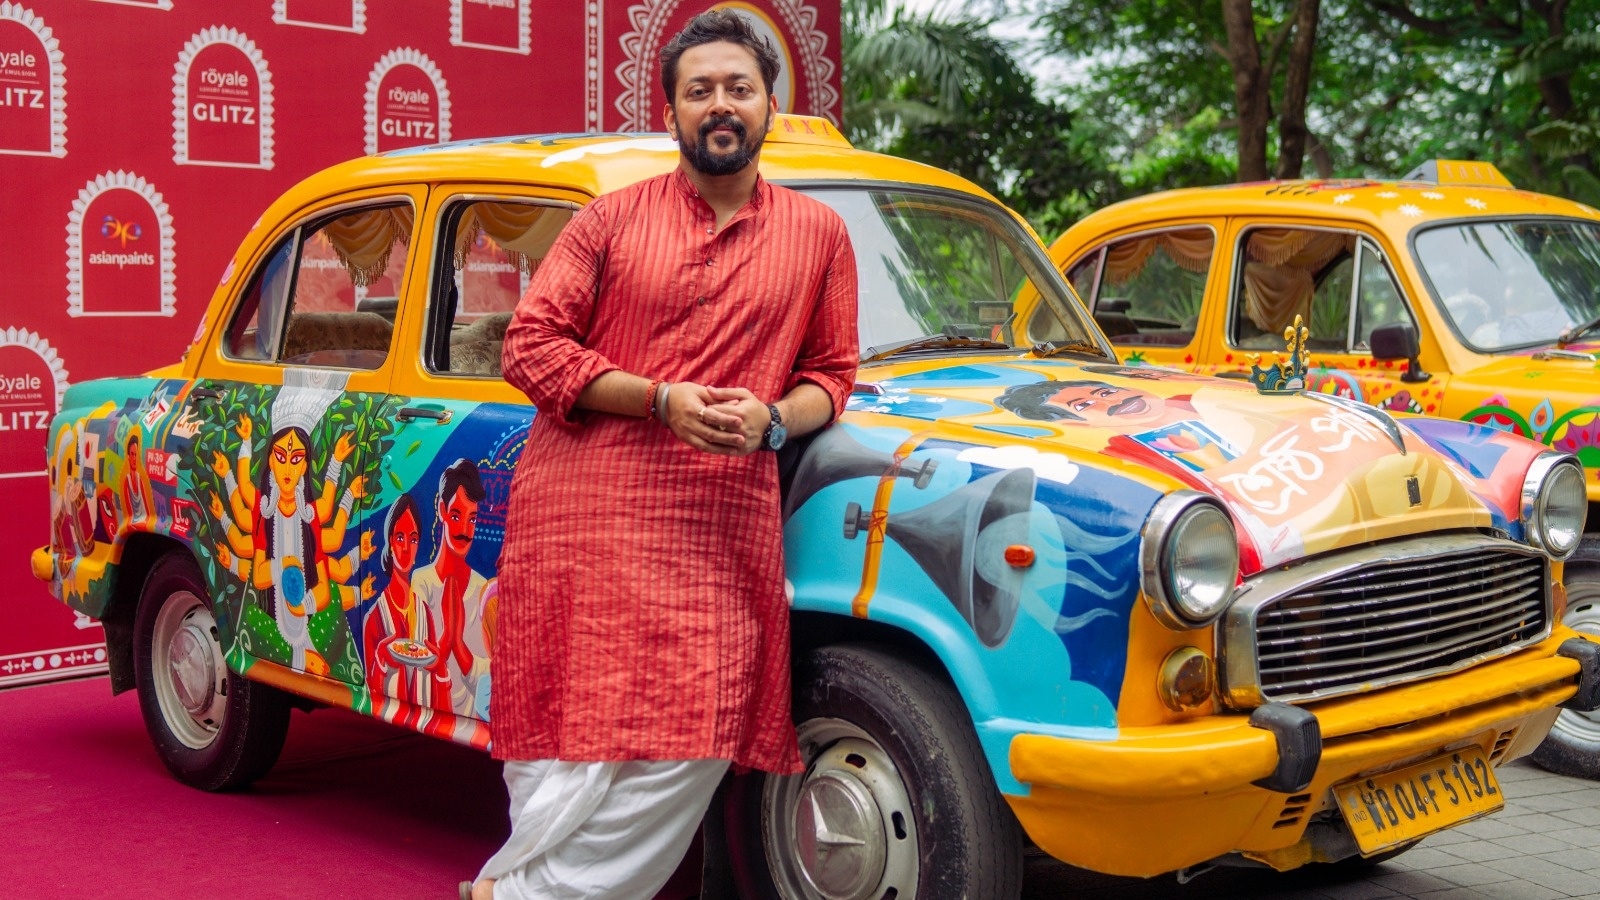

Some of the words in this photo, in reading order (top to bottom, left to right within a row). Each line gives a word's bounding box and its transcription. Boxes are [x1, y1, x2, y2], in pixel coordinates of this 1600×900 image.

[0, 87, 45, 109] ITZ
[192, 102, 256, 125] GLITZ
[381, 118, 436, 140] GLITZ
[783, 118, 830, 135] AXI
[1444, 164, 1496, 180] TAXI
[89, 250, 155, 270] asianpaints
[1437, 758, 1497, 807] 5192
[1352, 810, 1368, 823] IND
